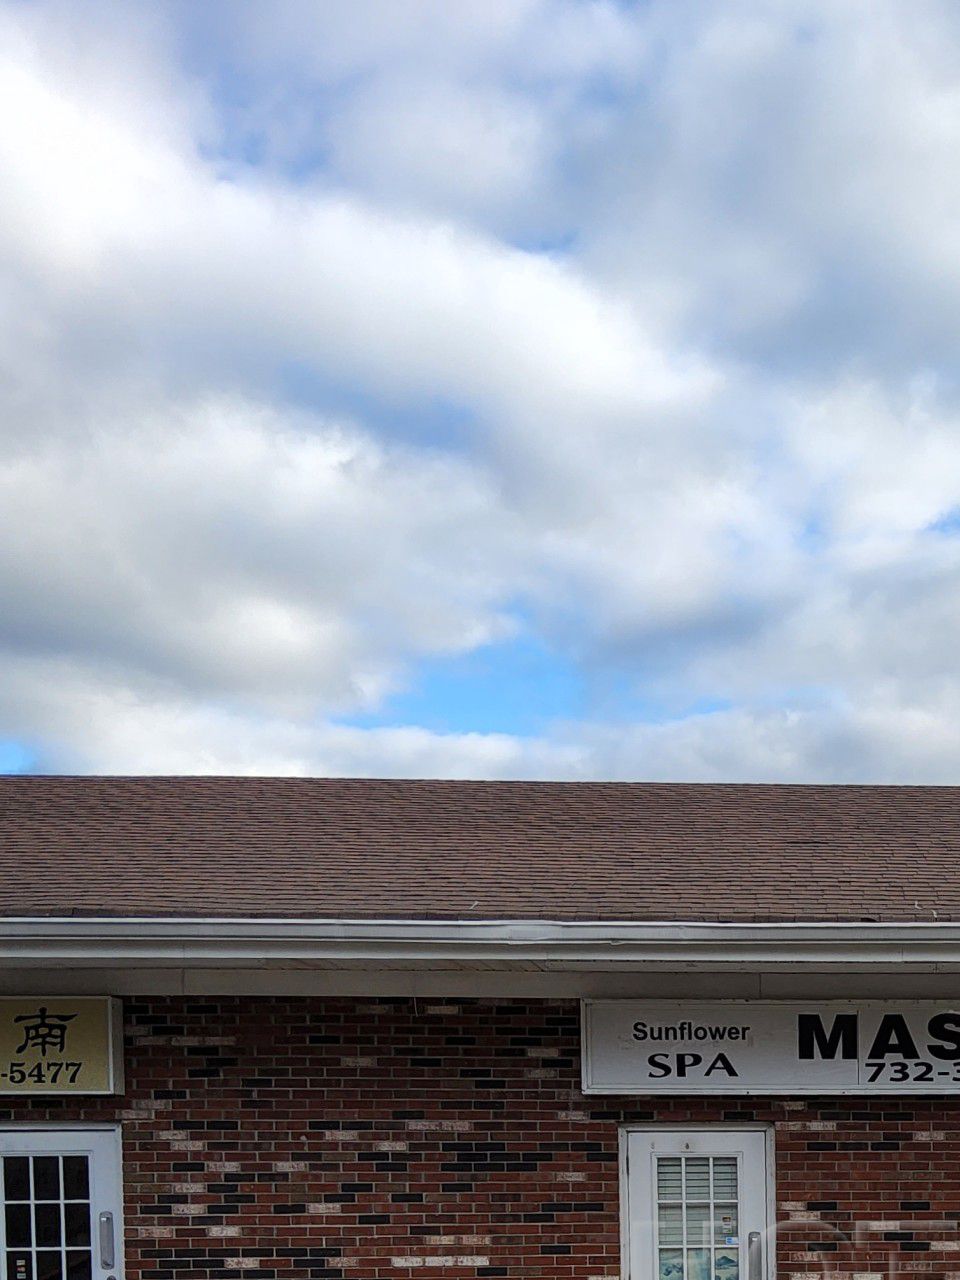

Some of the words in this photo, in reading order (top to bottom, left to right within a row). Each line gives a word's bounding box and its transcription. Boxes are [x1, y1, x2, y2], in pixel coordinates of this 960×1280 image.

[14, 1007, 79, 1056] 南
[632, 1022, 750, 1042] Sunflower
[648, 1053, 738, 1078] SPA
